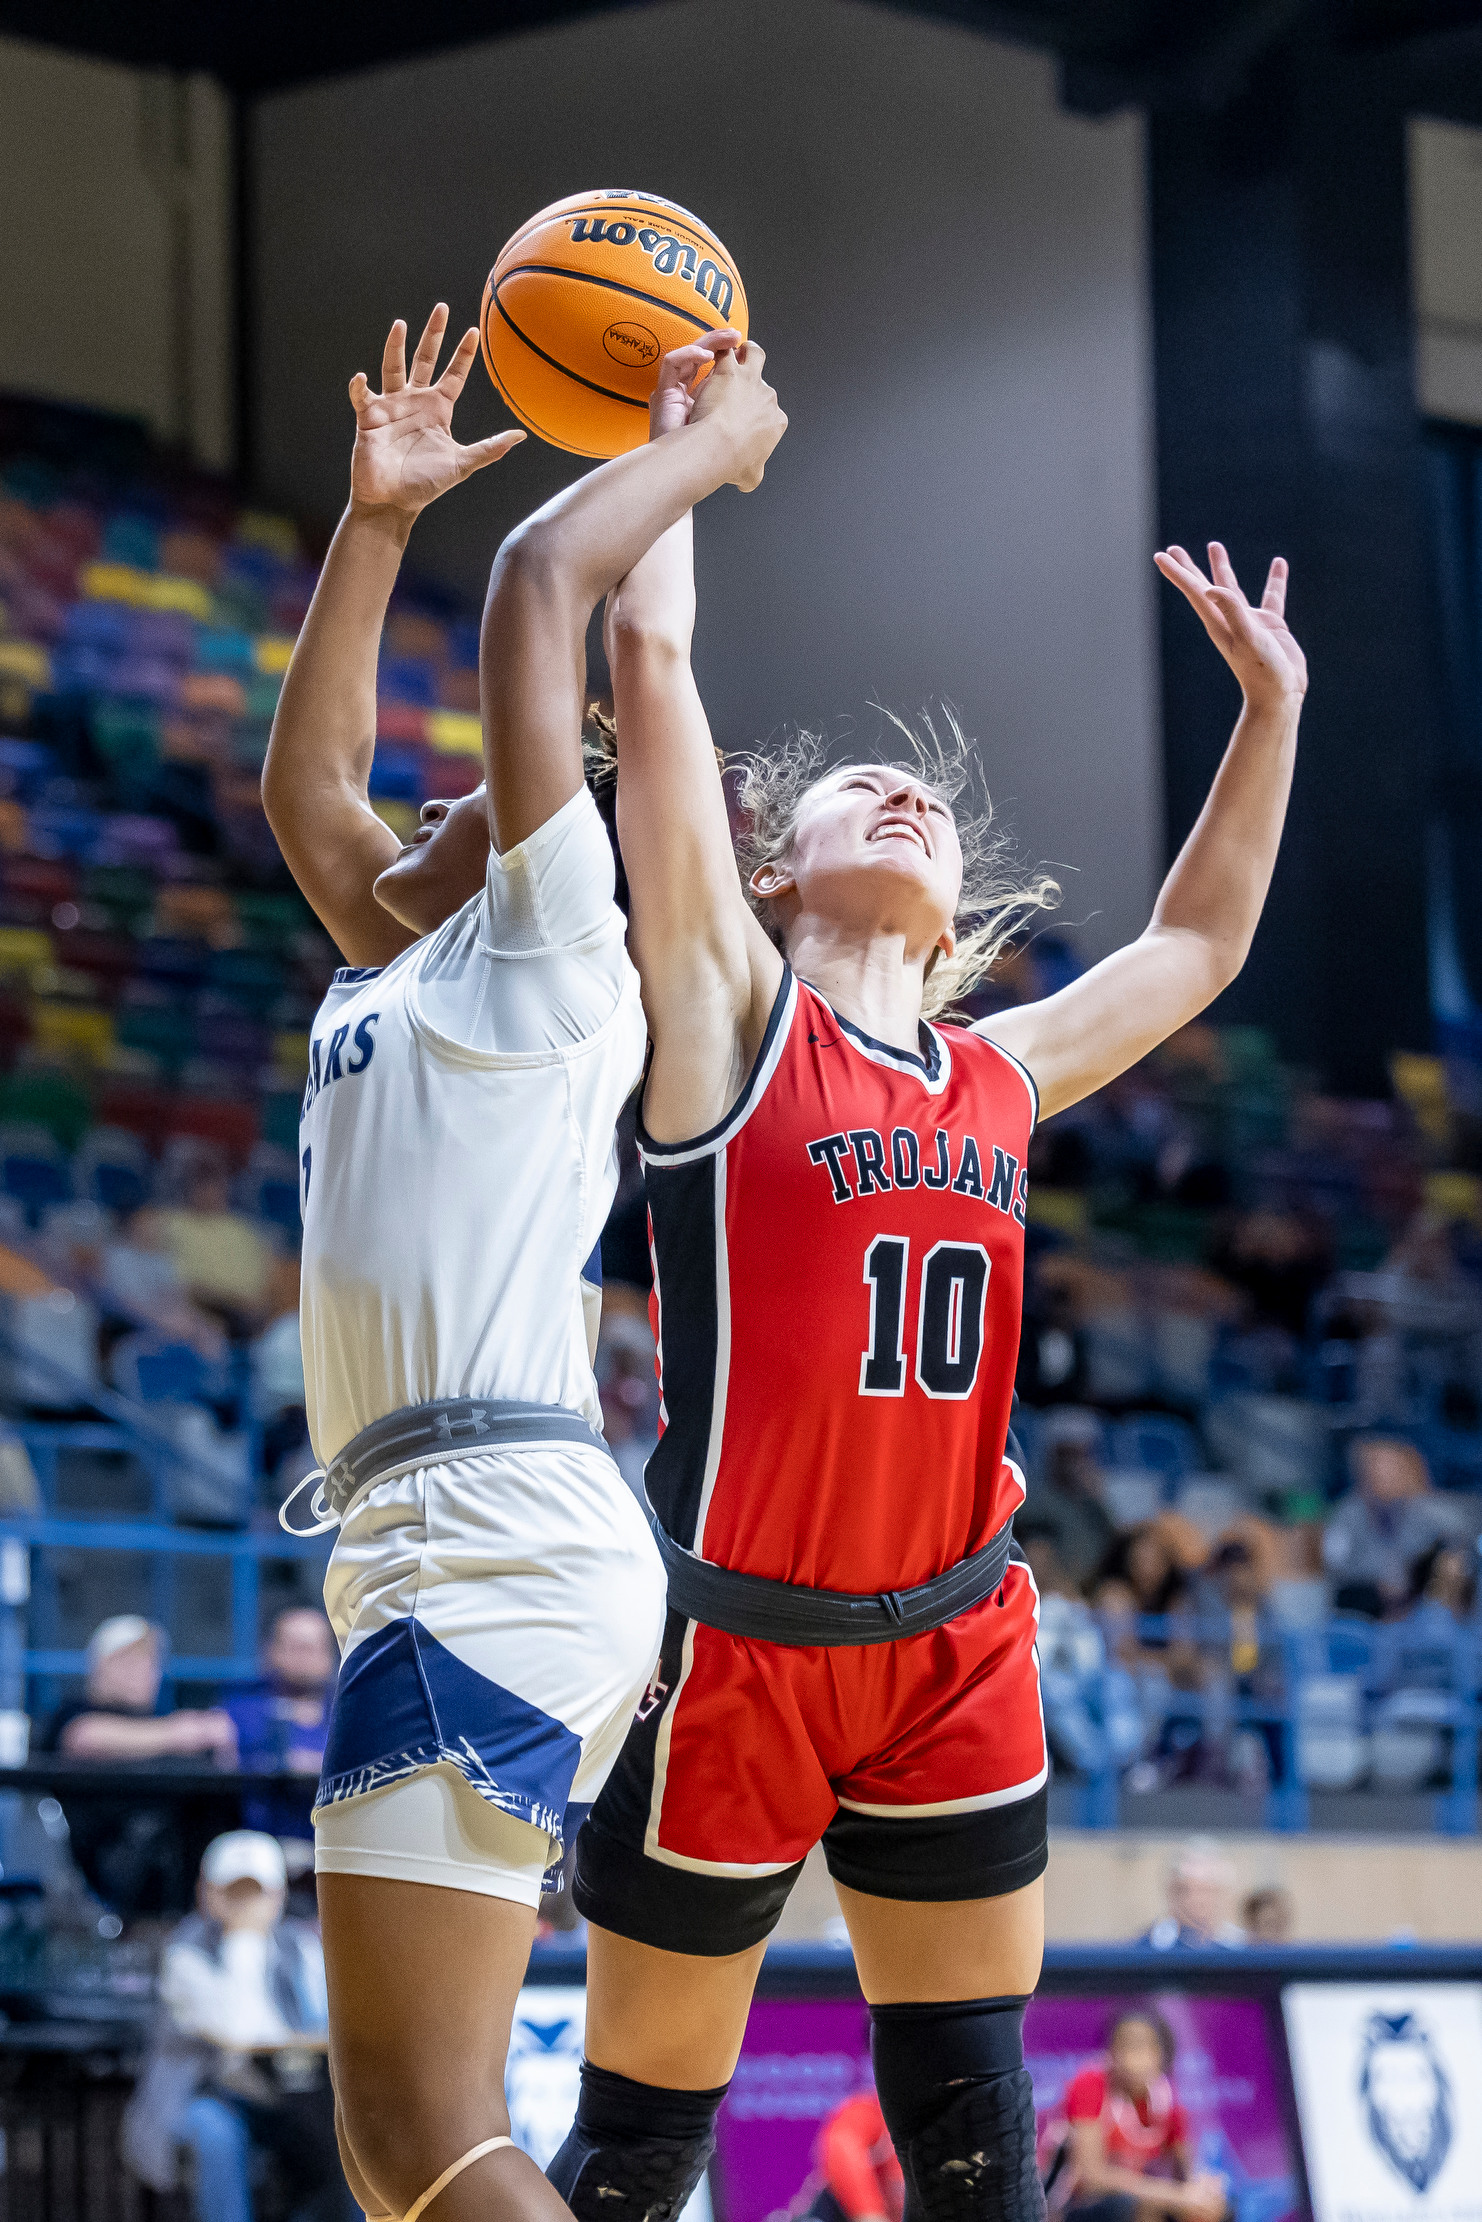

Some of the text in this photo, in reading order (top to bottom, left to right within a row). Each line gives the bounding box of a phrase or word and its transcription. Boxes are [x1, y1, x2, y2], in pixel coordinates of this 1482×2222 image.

[570, 218, 733, 322] Wilson
[806, 1126, 1028, 1229] TROJANS
[858, 1233, 992, 1400] 10
